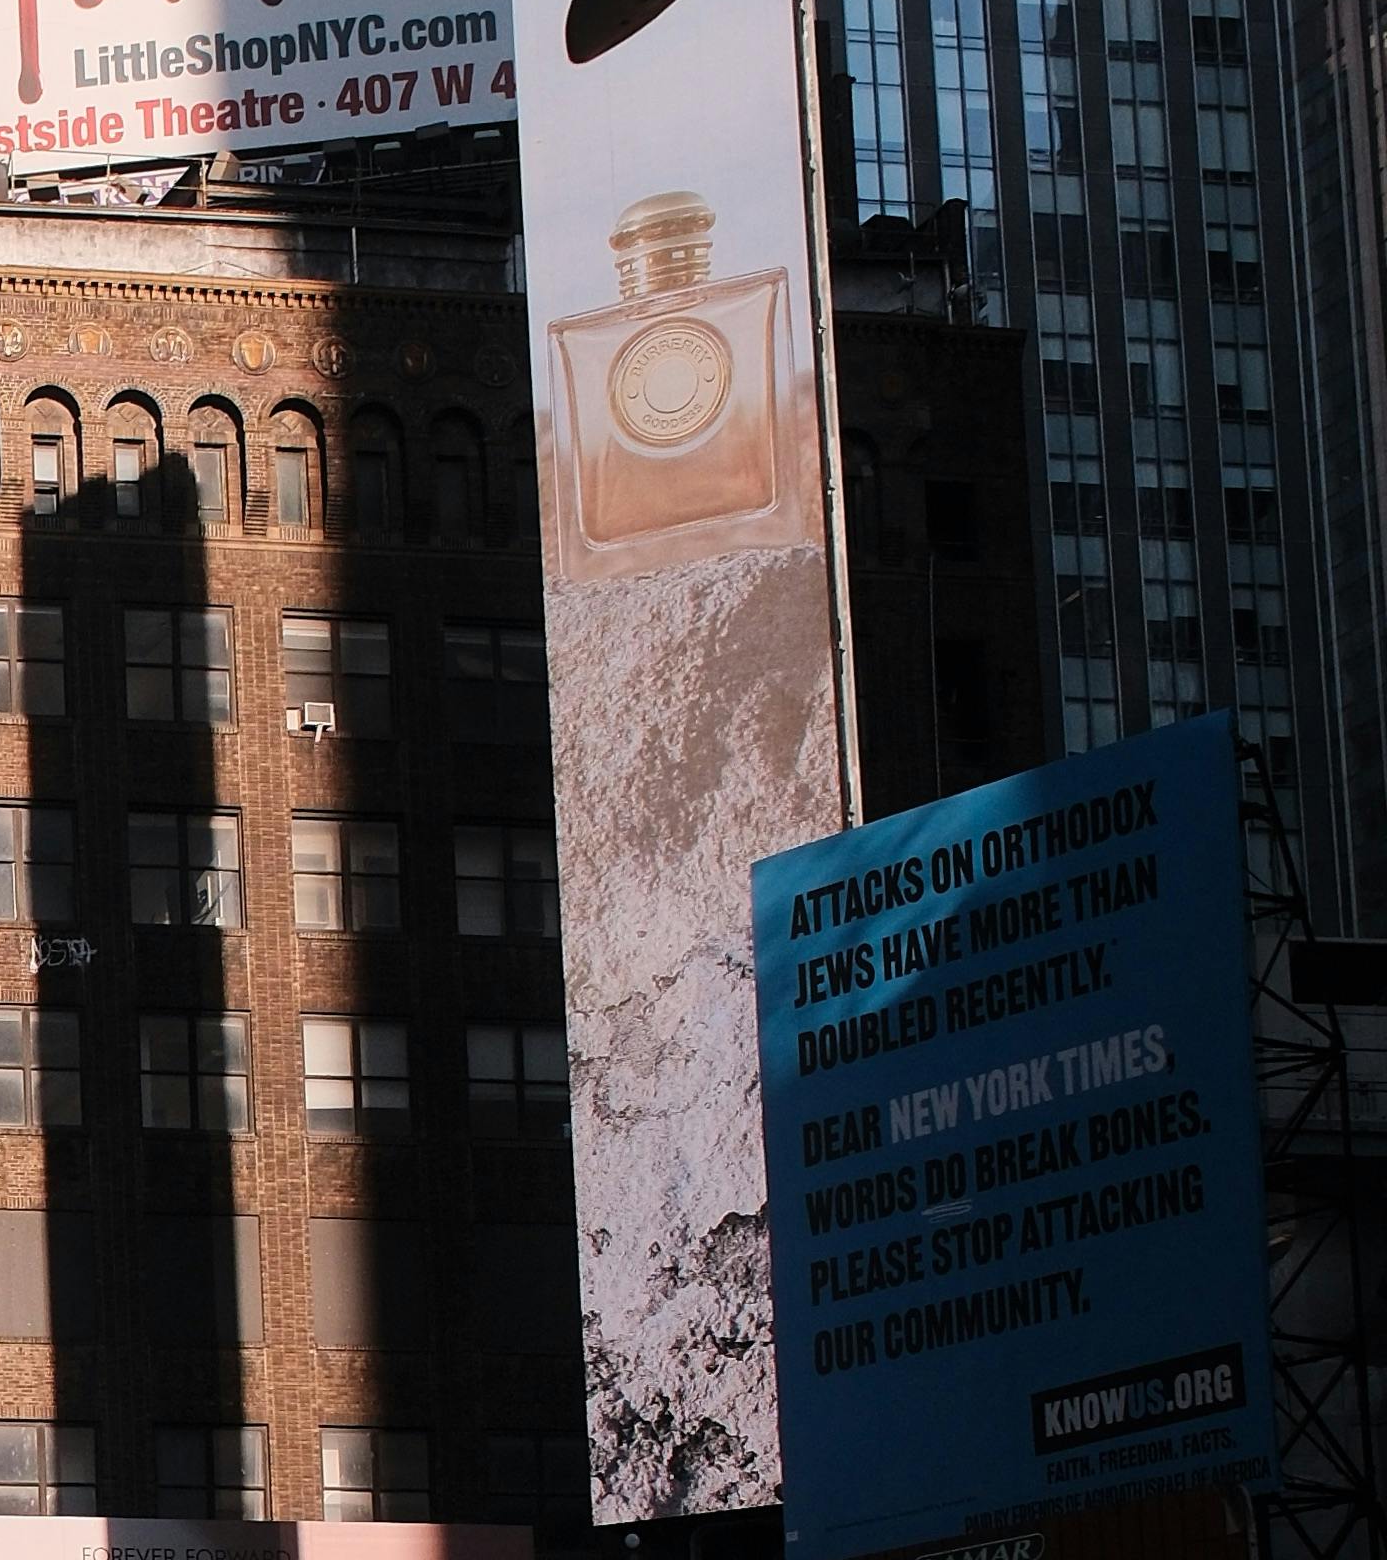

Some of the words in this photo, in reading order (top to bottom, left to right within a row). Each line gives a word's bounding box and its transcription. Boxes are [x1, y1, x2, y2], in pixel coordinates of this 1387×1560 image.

[74, 10, 496, 88] LittleShopNYC.com
[136, 89, 305, 139] Theatre
[335, 72, 415, 116] 407
[432, 66, 476, 105] W
[791, 858, 924, 940] ATTACKS
[931, 839, 974, 894] ON
[982, 779, 1158, 878] ORTHODOX
[795, 943, 875, 1009] JEWS
[884, 915, 962, 981] HAVE
[970, 883, 1062, 954] MORE
[1067, 854, 1158, 923] THAN
[798, 994, 937, 1077] DOUBLED
[803, 1105, 881, 1167] DEAR
[889, 1080, 960, 1143] NEW
[965, 1054, 1053, 1121] YORK
[1057, 1024, 1175, 1096] TIMES,
[805, 1166, 917, 1236] WORDS
[925, 1153, 966, 1205] DO
[975, 1119, 1082, 1193] BREAK
[1088, 1090, 1211, 1162] BONES.
[810, 1236, 924, 1306] PLEASE
[932, 1208, 1012, 1275] STOP
[1020, 1165, 1203, 1254] ATTACKING
[814, 1321, 875, 1376] OUR
[884, 1268, 1091, 1359] COMMUNITY.
[1043, 1363, 1233, 1439] KNOWUS.ORG
[1098, 1439, 1177, 1474] FREEDOM.
